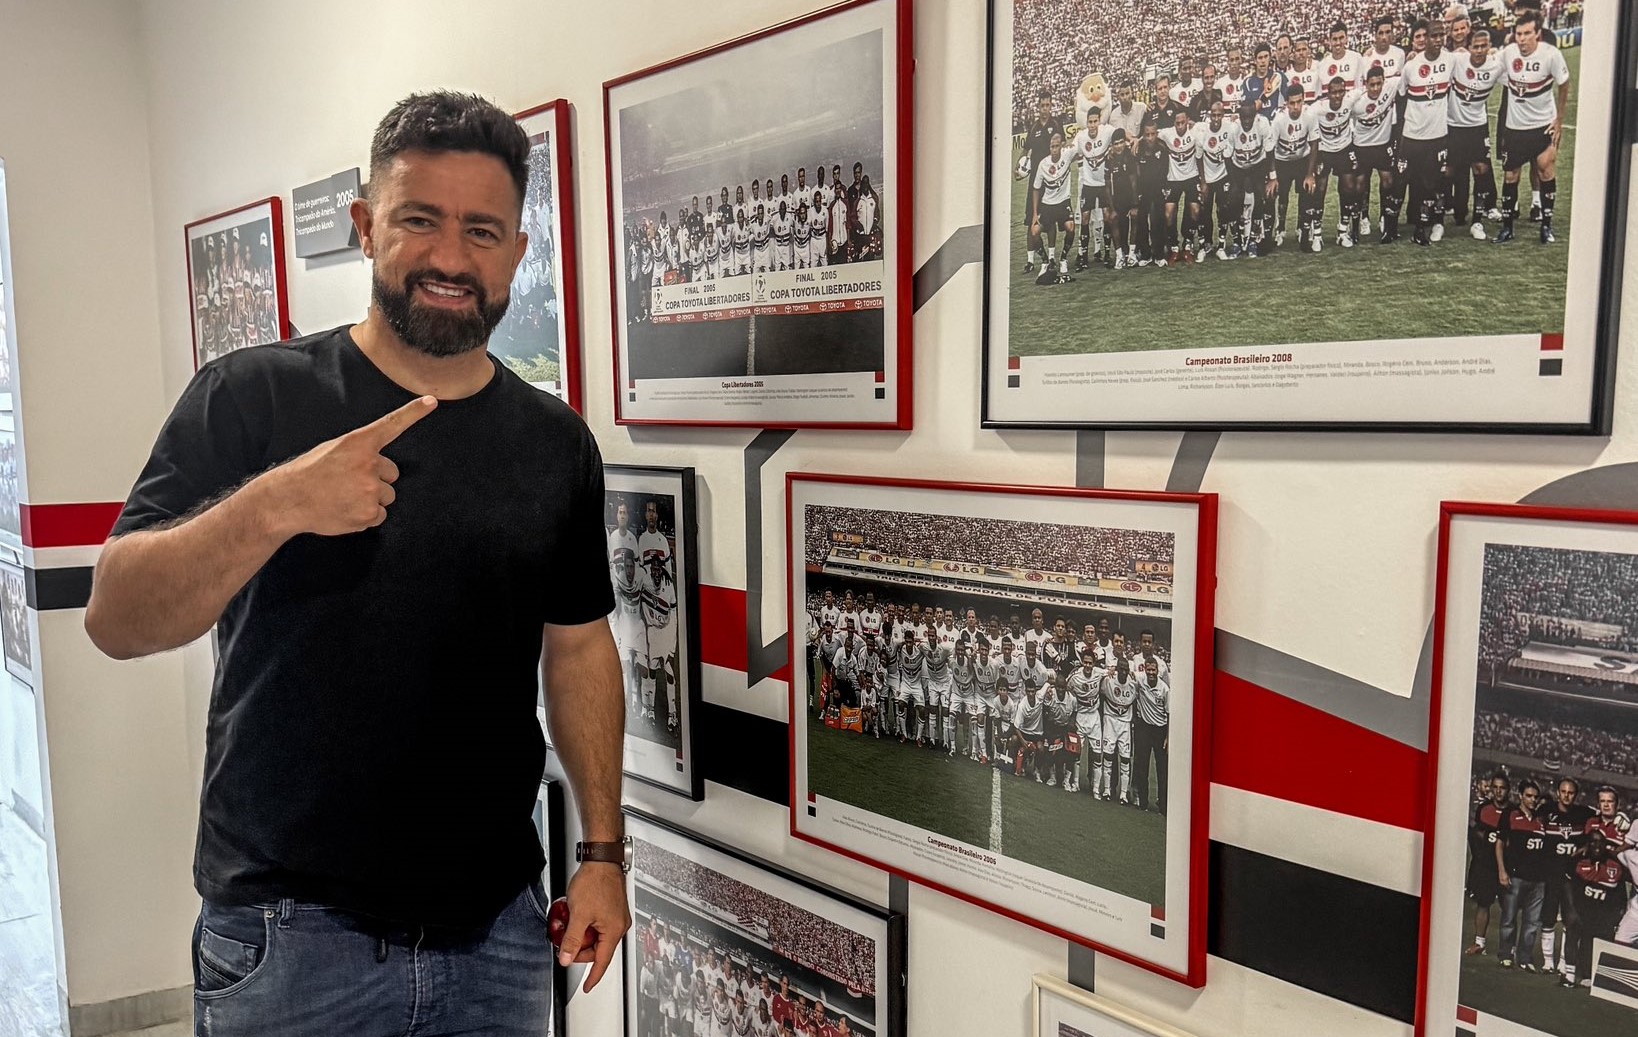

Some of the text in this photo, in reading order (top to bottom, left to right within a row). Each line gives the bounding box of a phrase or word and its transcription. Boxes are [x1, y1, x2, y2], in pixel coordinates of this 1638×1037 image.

[1340, 64, 1350, 72] LG
[1384, 59, 1394, 67] LG
[1526, 62, 1540, 72] LG
[1433, 64, 1446, 73] LG
[1477, 72, 1490, 81] LG
[1093, 141, 1103, 149] LG
[795, 270, 837, 282] FINAL 2005
[685, 284, 716, 295] FINAL 2005
[770, 290, 790, 299] COPA
[791, 287, 821, 298] TOYOTA
[822, 280, 882, 295] LIBERTADORES
[666, 301, 681, 310] COPA
[681, 297, 704, 308] TOYOTA
[704, 292, 751, 306] LIBERTADORES
[863, 299, 883, 307] TOYOTA
[1185, 353, 1293, 367] Campeonato Brasileiro 2008
[722, 382, 731, 390] Copa
[1047, 576, 1066, 584] LG
[1147, 586, 1170, 594] LG
[953, 586, 1012, 597] MUNDIAL
[1038, 597, 1108, 609] FUTEBOL
[1123, 690, 1131, 698] LG
[927, 836, 958, 853] Campeonato
[958, 846, 983, 861] Brasileiro
[1585, 886, 1607, 901] STI
